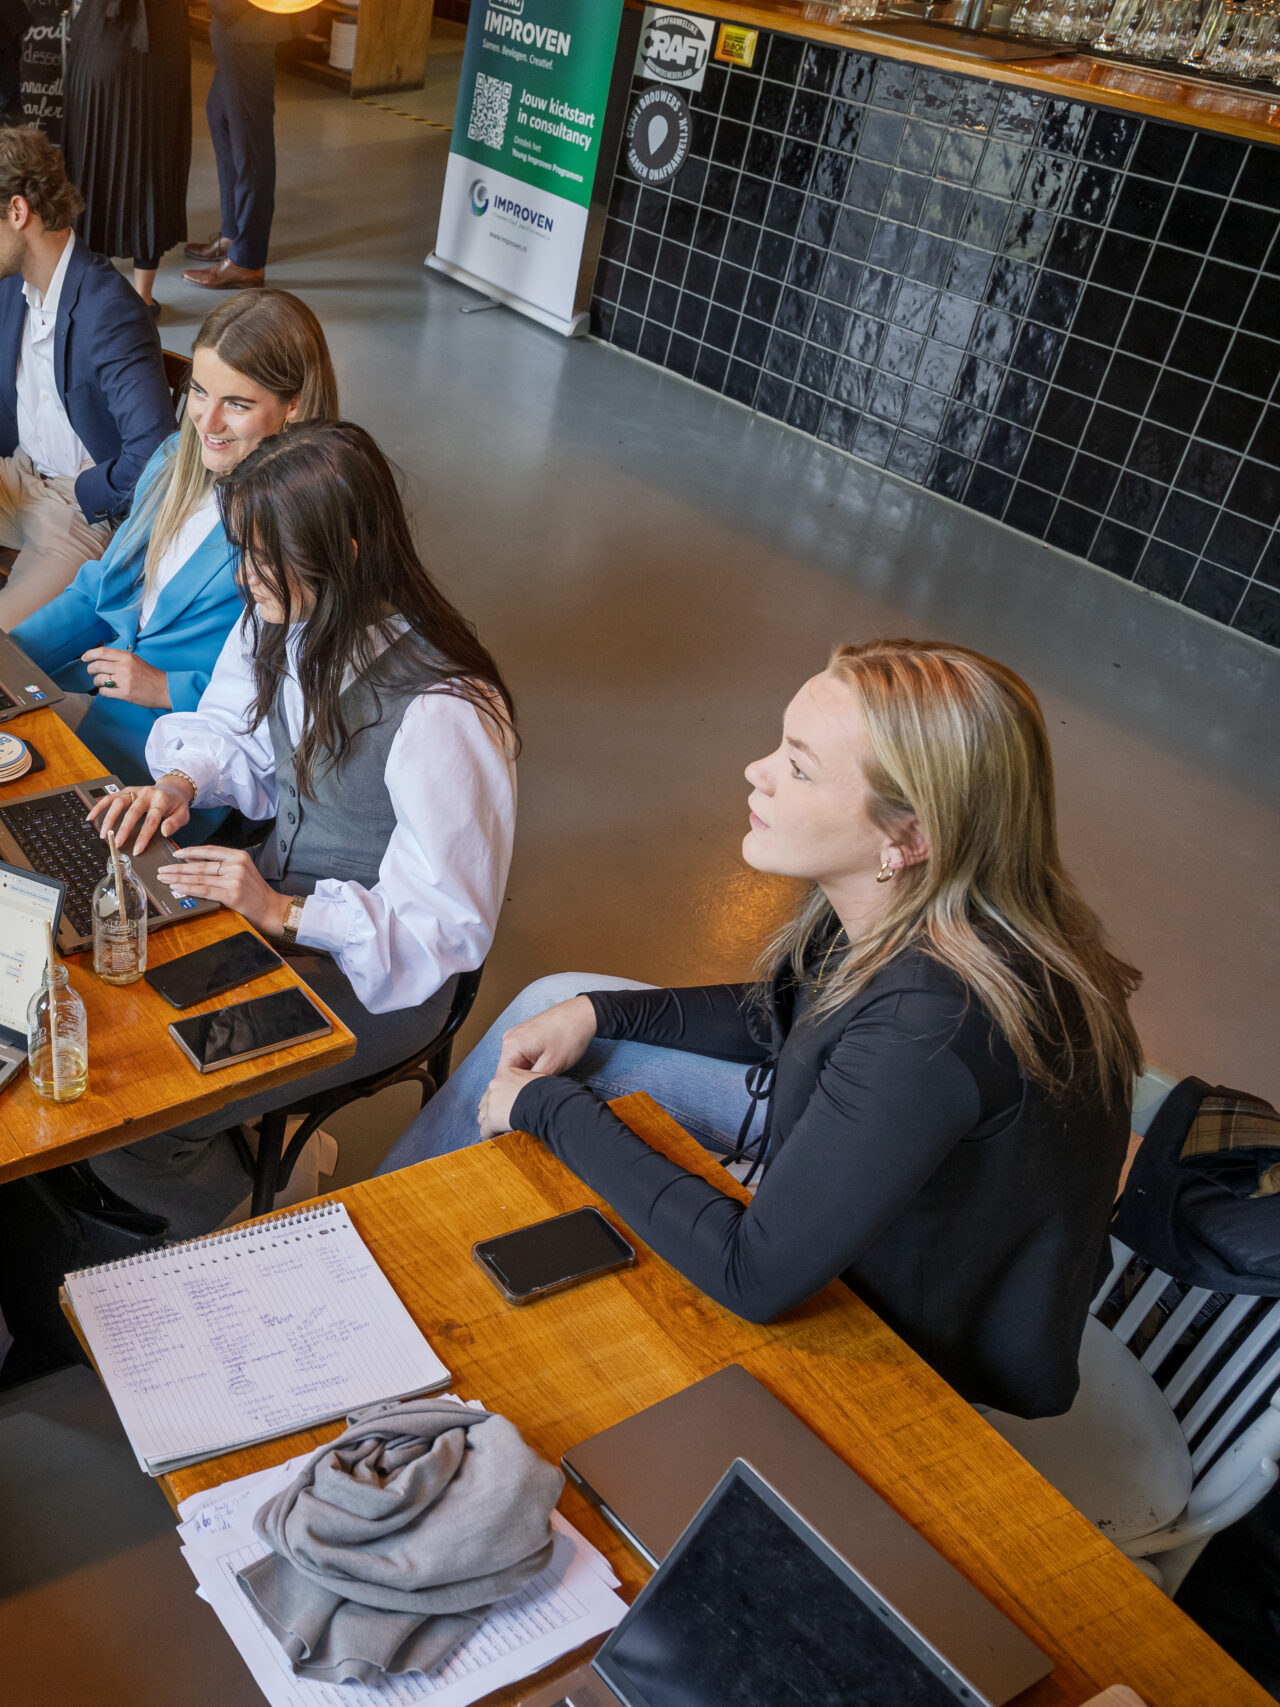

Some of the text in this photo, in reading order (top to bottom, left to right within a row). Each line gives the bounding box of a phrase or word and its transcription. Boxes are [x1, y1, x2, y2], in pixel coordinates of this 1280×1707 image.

[484, 10, 571, 56] IMPROVEN
[642, 28, 707, 69] CRAFT
[517, 108, 592, 151] in consultancy
[520, 89, 595, 128] Jouw kickstart
[626, 90, 681, 138] CRAFT BROUWERS
[628, 116, 689, 181] SAMEN ONAFHANKELIJK
[493, 195, 554, 232] IMPROVEN
